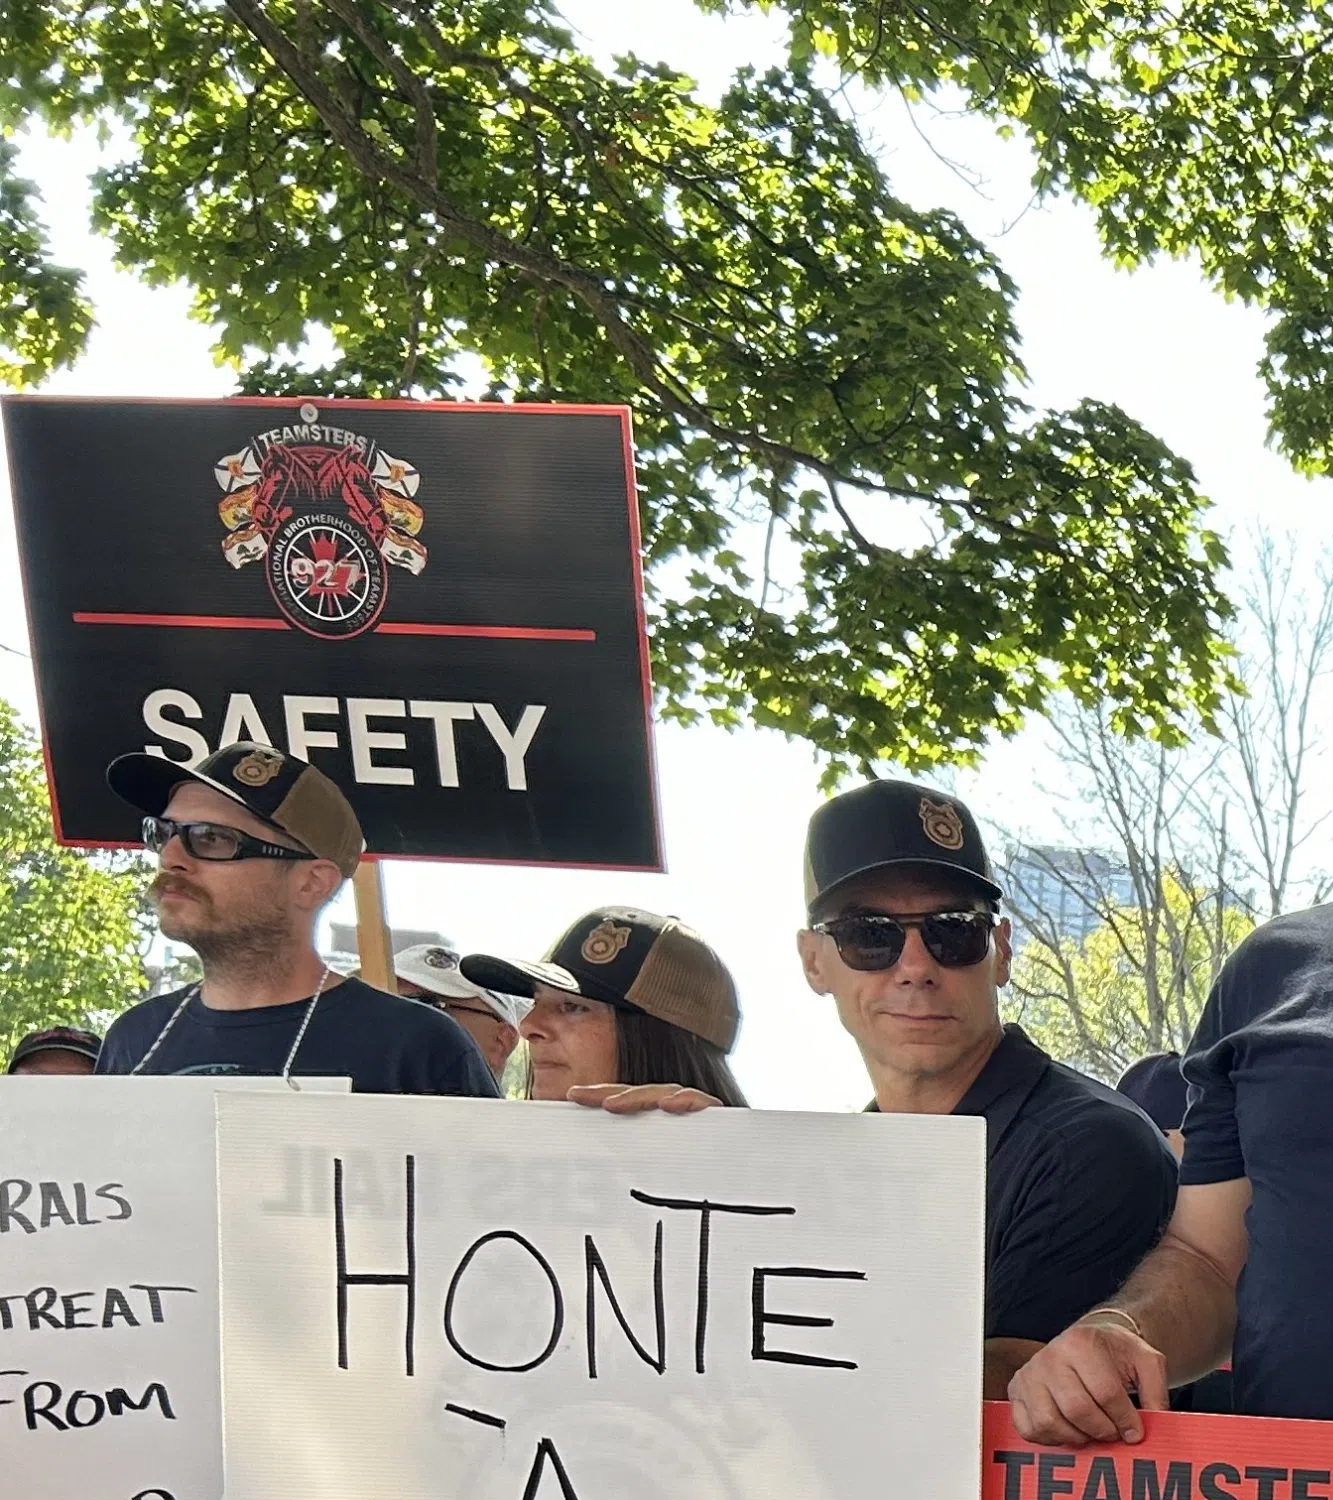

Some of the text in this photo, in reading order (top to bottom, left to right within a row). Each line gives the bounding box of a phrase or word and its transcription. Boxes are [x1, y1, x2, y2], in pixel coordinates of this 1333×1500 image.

[258, 424, 368, 451] TEAMSTERS
[285, 513, 367, 549] BROTHERHOOD
[290, 557, 362, 590] 927
[142, 687, 547, 791] SAFETY
[333, 1154, 868, 1379] HONTE
